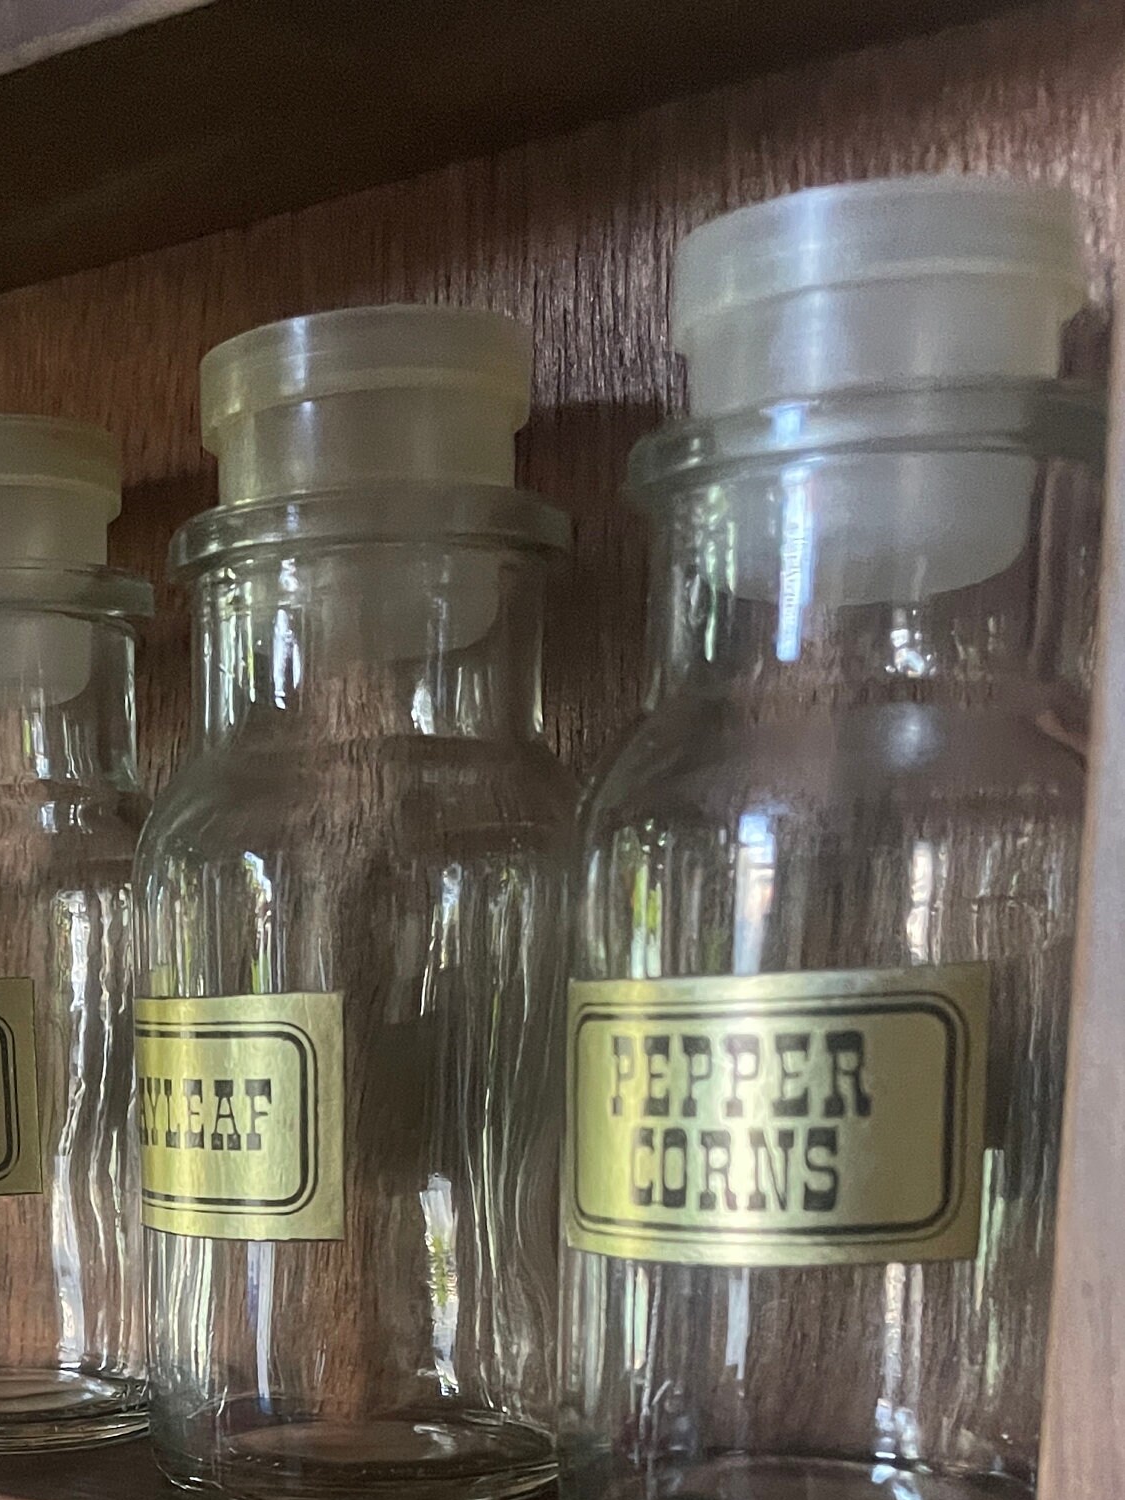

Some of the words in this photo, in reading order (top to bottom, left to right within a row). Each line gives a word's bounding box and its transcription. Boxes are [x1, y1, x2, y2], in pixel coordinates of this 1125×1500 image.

[138, 1076, 272, 1151] AYLEAF
[610, 1030, 872, 1118] PEPPER
[631, 1126, 841, 1212] CORNS
